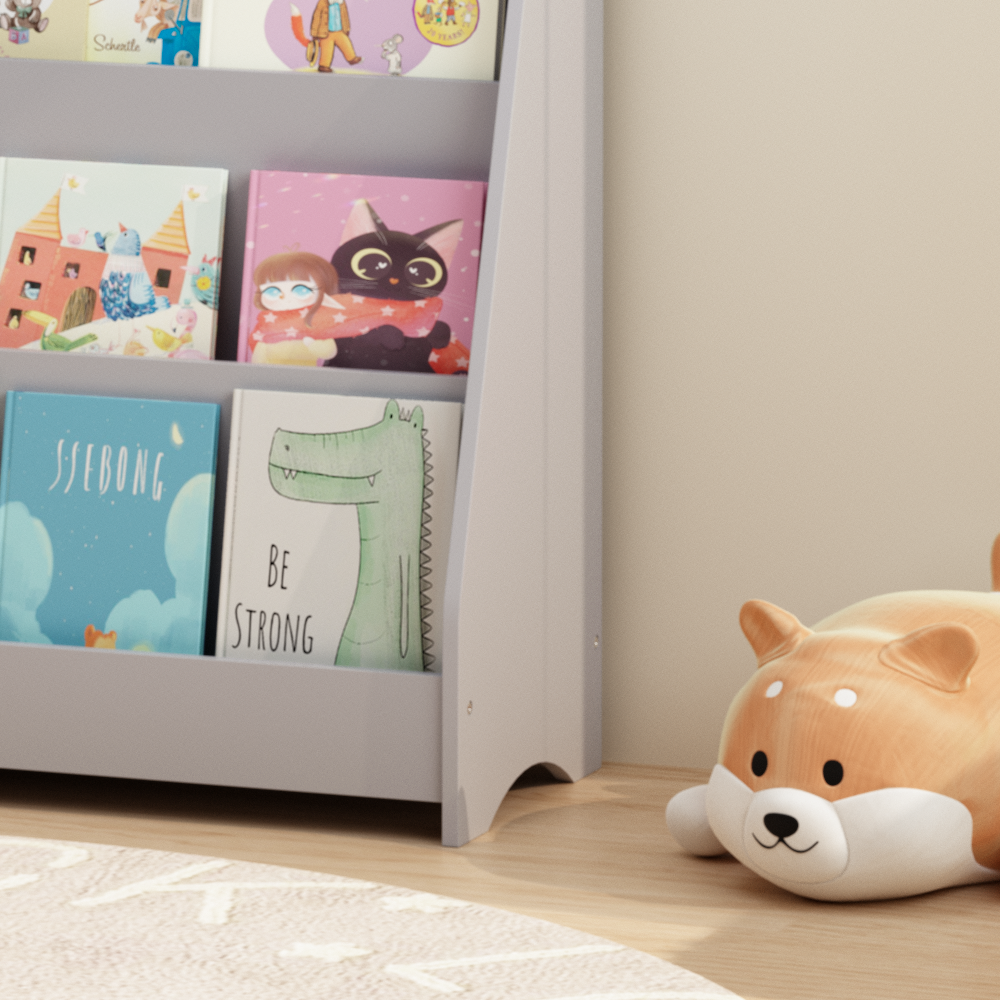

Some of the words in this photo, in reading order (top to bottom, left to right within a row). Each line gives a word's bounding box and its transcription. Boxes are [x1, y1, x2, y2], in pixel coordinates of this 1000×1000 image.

[48, 438, 165, 501] SSEBONG
[267, 543, 290, 590] BE
[231, 602, 314, 655] STRONG
